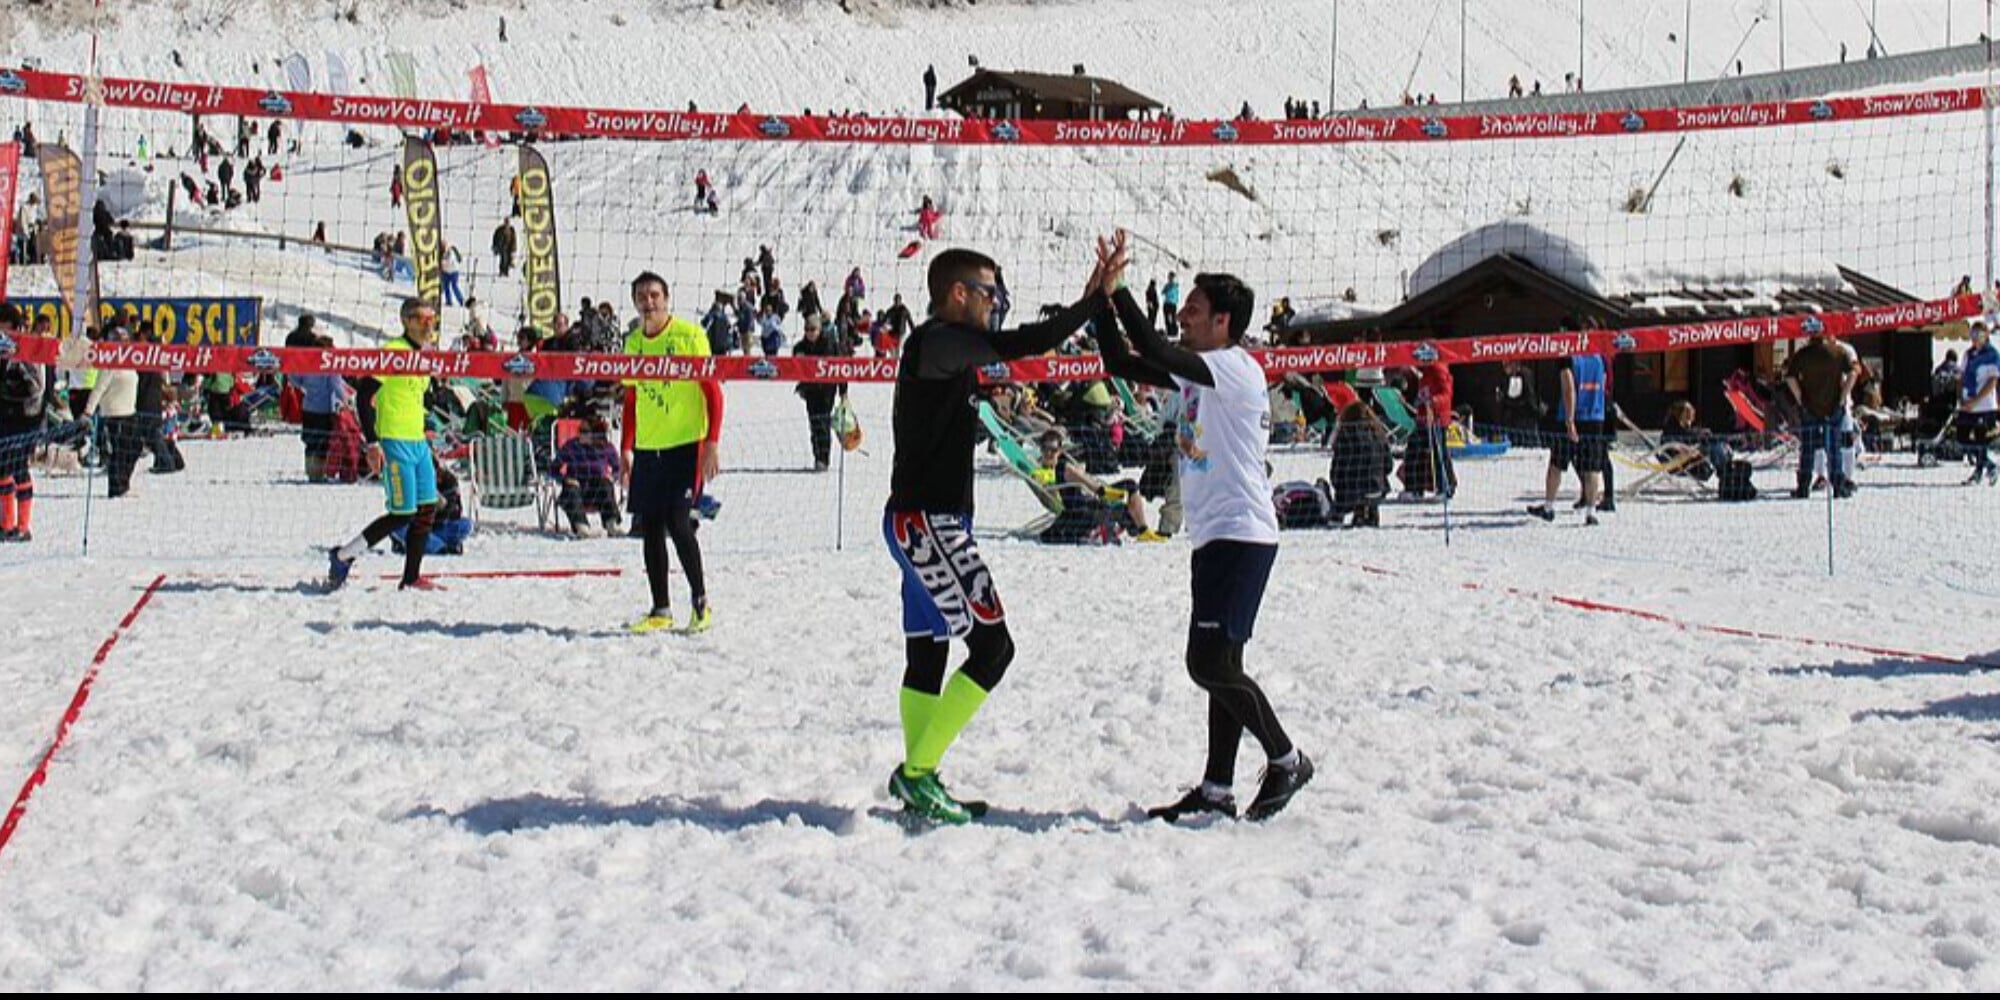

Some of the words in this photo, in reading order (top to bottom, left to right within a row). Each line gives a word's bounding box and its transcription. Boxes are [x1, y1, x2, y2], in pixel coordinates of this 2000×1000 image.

[330, 97, 482, 127] SnowVolley.it
[584, 111, 730, 138] SnowVolley.it
[825, 118, 963, 143] SnowVolley.it
[1055, 120, 1186, 143] SnowVolley.it
[1272, 119, 1397, 141] SnowVolley.it
[1479, 116, 1598, 136] SnowVolley.it
[1676, 103, 1788, 127] SnowVolley.it
[186, 302, 236, 345] SCI
[84, 345, 213, 370] owVolley.it
[319, 350, 471, 375] SnowVolley.it
[573, 356, 717, 380] SnowVolley.it
[815, 358, 900, 378] SnowVol
[1264, 344, 1388, 369] SnowVolley.it
[1471, 333, 1590, 357] SnowVolley.it
